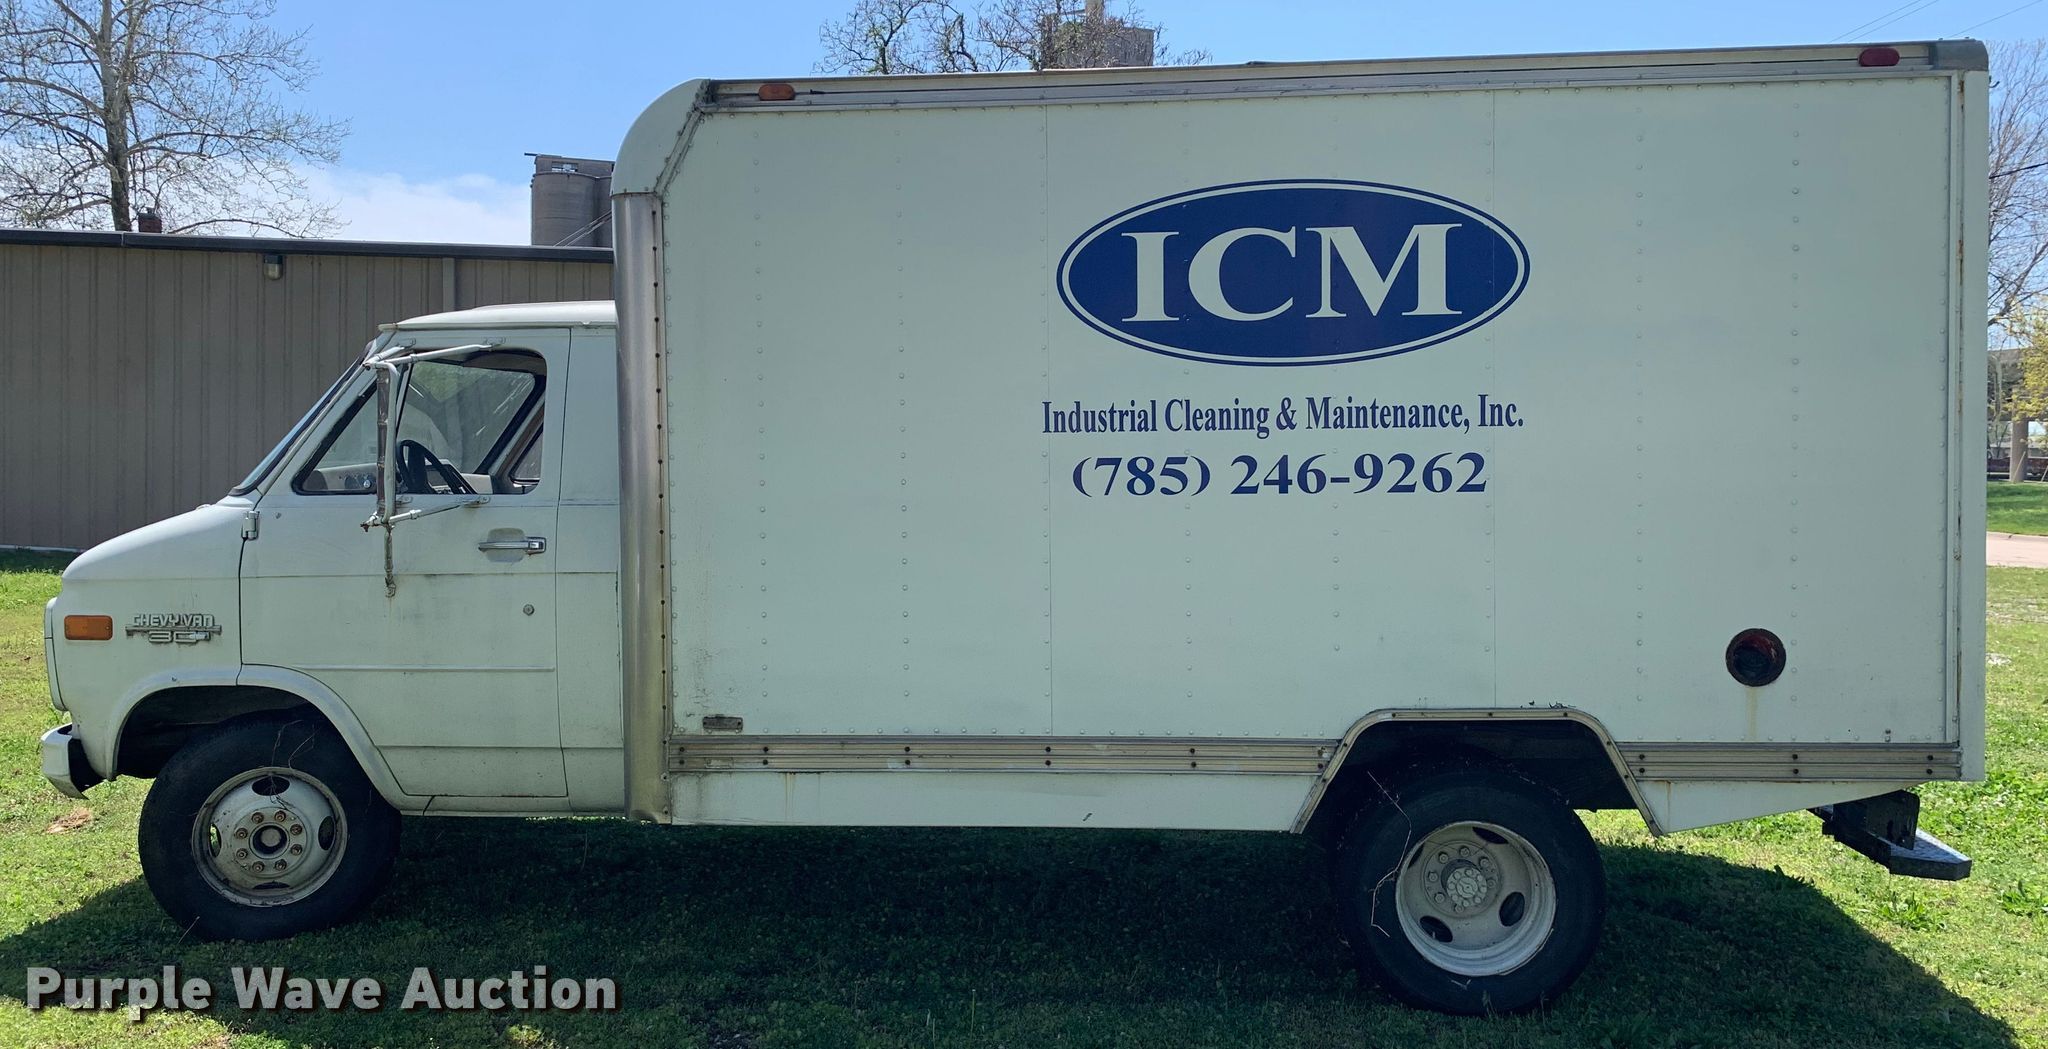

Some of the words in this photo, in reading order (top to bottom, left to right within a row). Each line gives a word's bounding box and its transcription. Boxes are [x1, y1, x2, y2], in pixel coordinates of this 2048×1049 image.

[1121, 223, 1463, 322] ICM
[1041, 399, 1158, 434] Industrial
[1164, 397, 1270, 440] Cleaning
[1275, 396, 1298, 431] &
[1305, 395, 1470, 435] Maintenance,
[1477, 393, 1524, 428] Inc.
[1072, 455, 1211, 498] (785)
[1230, 452, 1488, 495] 246-9262
